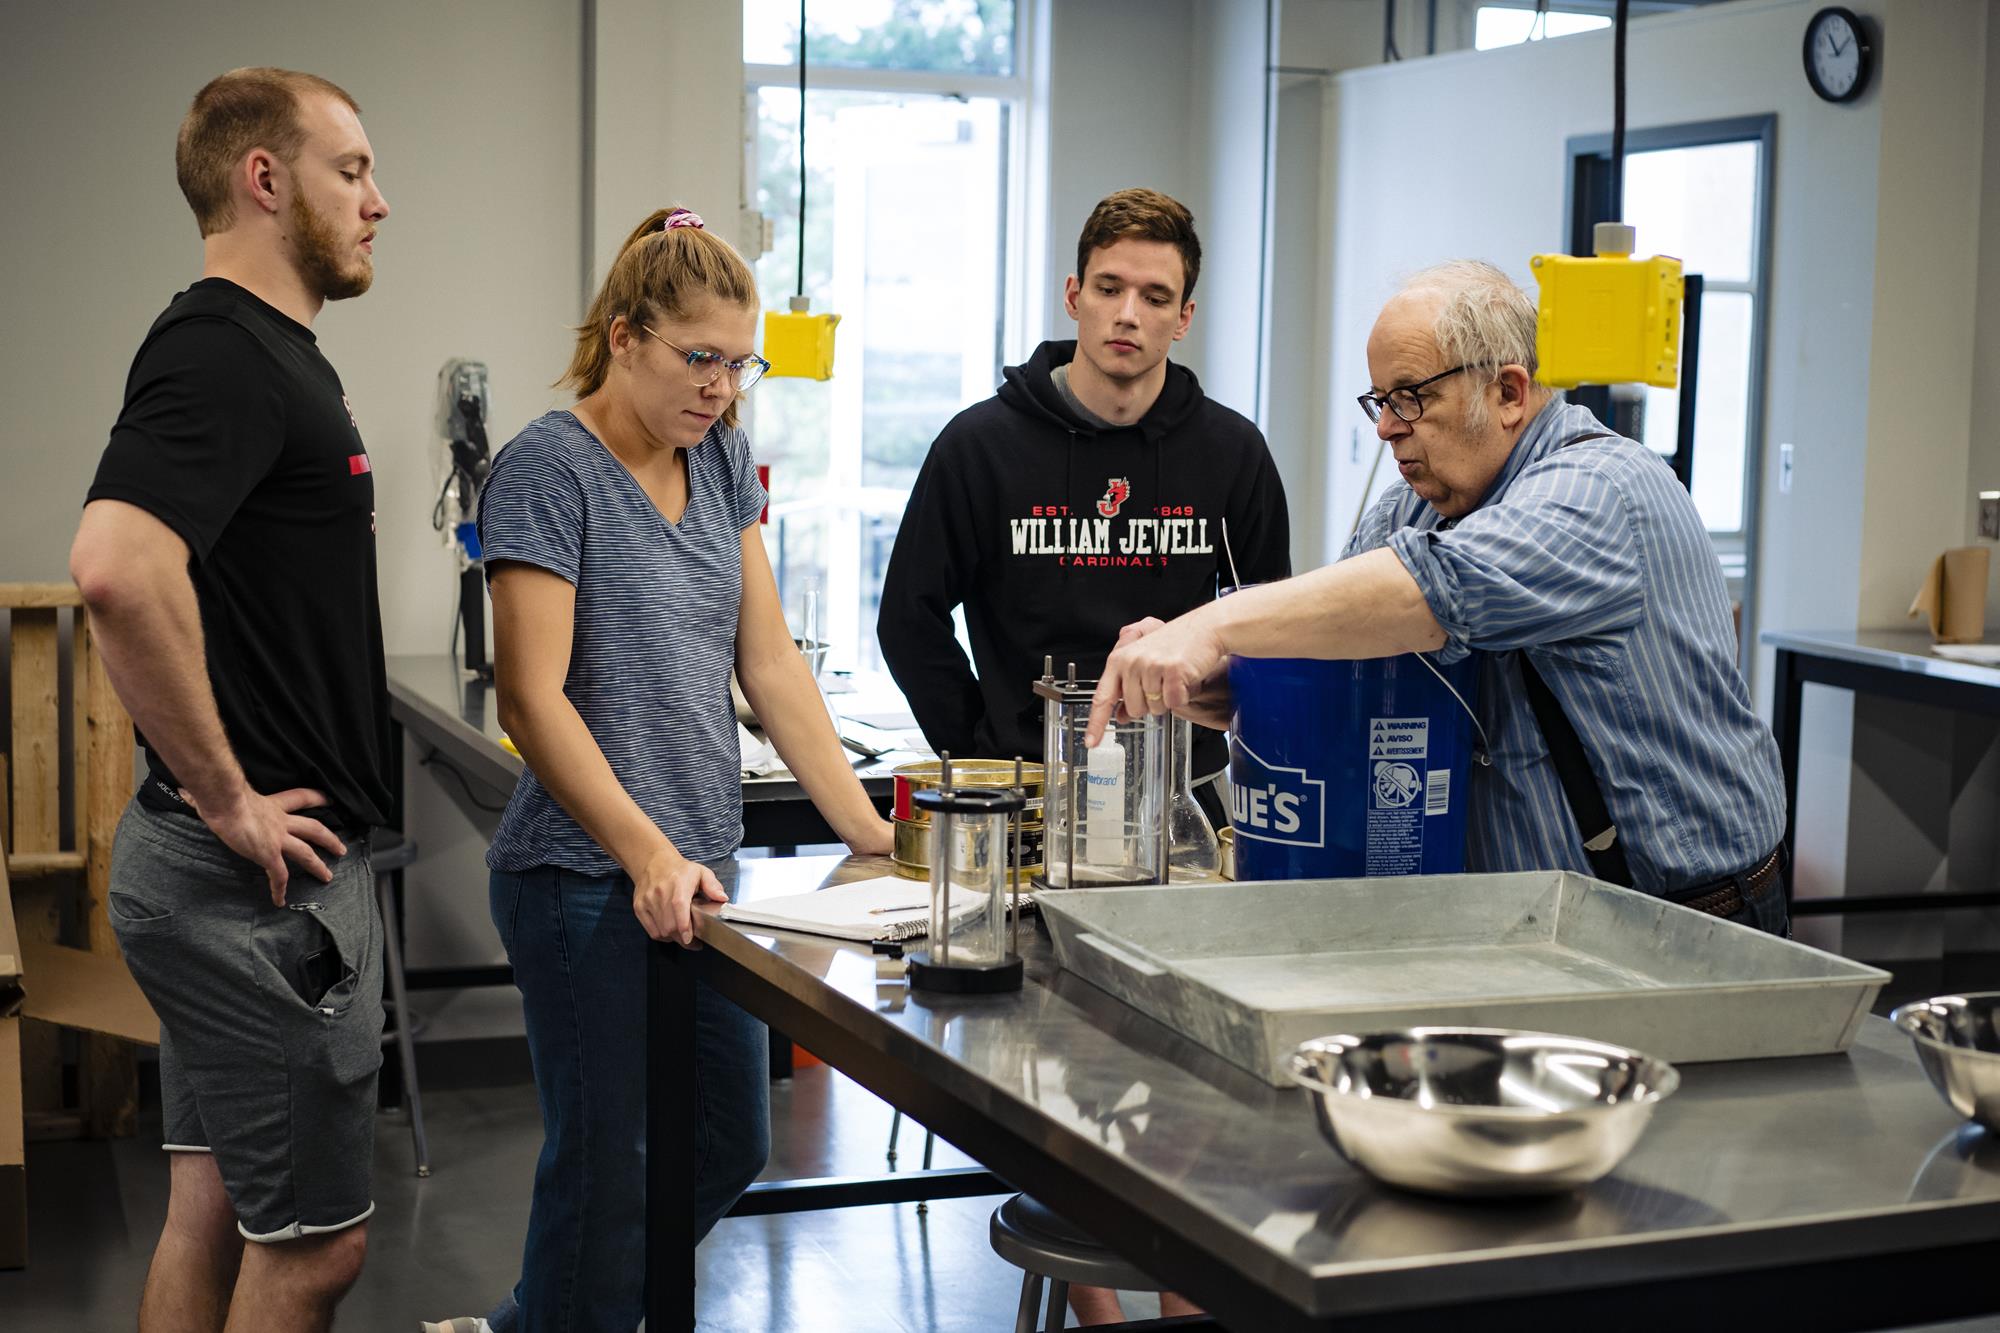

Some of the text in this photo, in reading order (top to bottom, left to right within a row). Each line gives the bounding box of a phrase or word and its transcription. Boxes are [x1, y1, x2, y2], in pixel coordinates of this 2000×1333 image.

[1032, 506, 1074, 516] EST.
[1010, 518, 1213, 555] WILLIAM JEWELL
[1387, 721, 1426, 730] WARNING
[1386, 734, 1413, 743] AVISO
[156, 781, 184, 803] JOCKE
